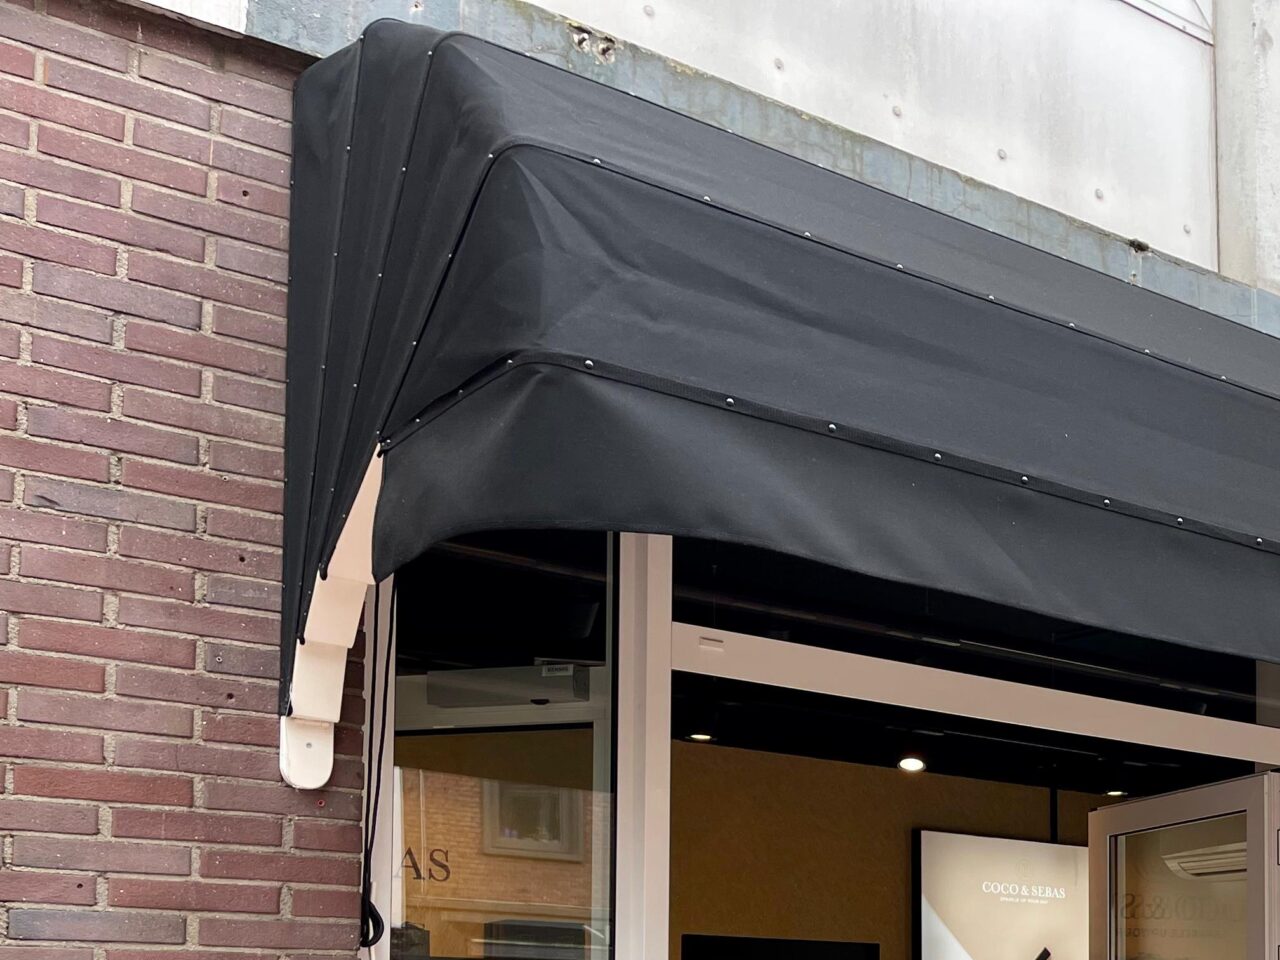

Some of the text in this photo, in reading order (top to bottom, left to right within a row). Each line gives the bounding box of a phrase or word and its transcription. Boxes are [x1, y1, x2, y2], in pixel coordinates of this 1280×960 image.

[982, 881, 1066, 899] COCO & SEBAS
